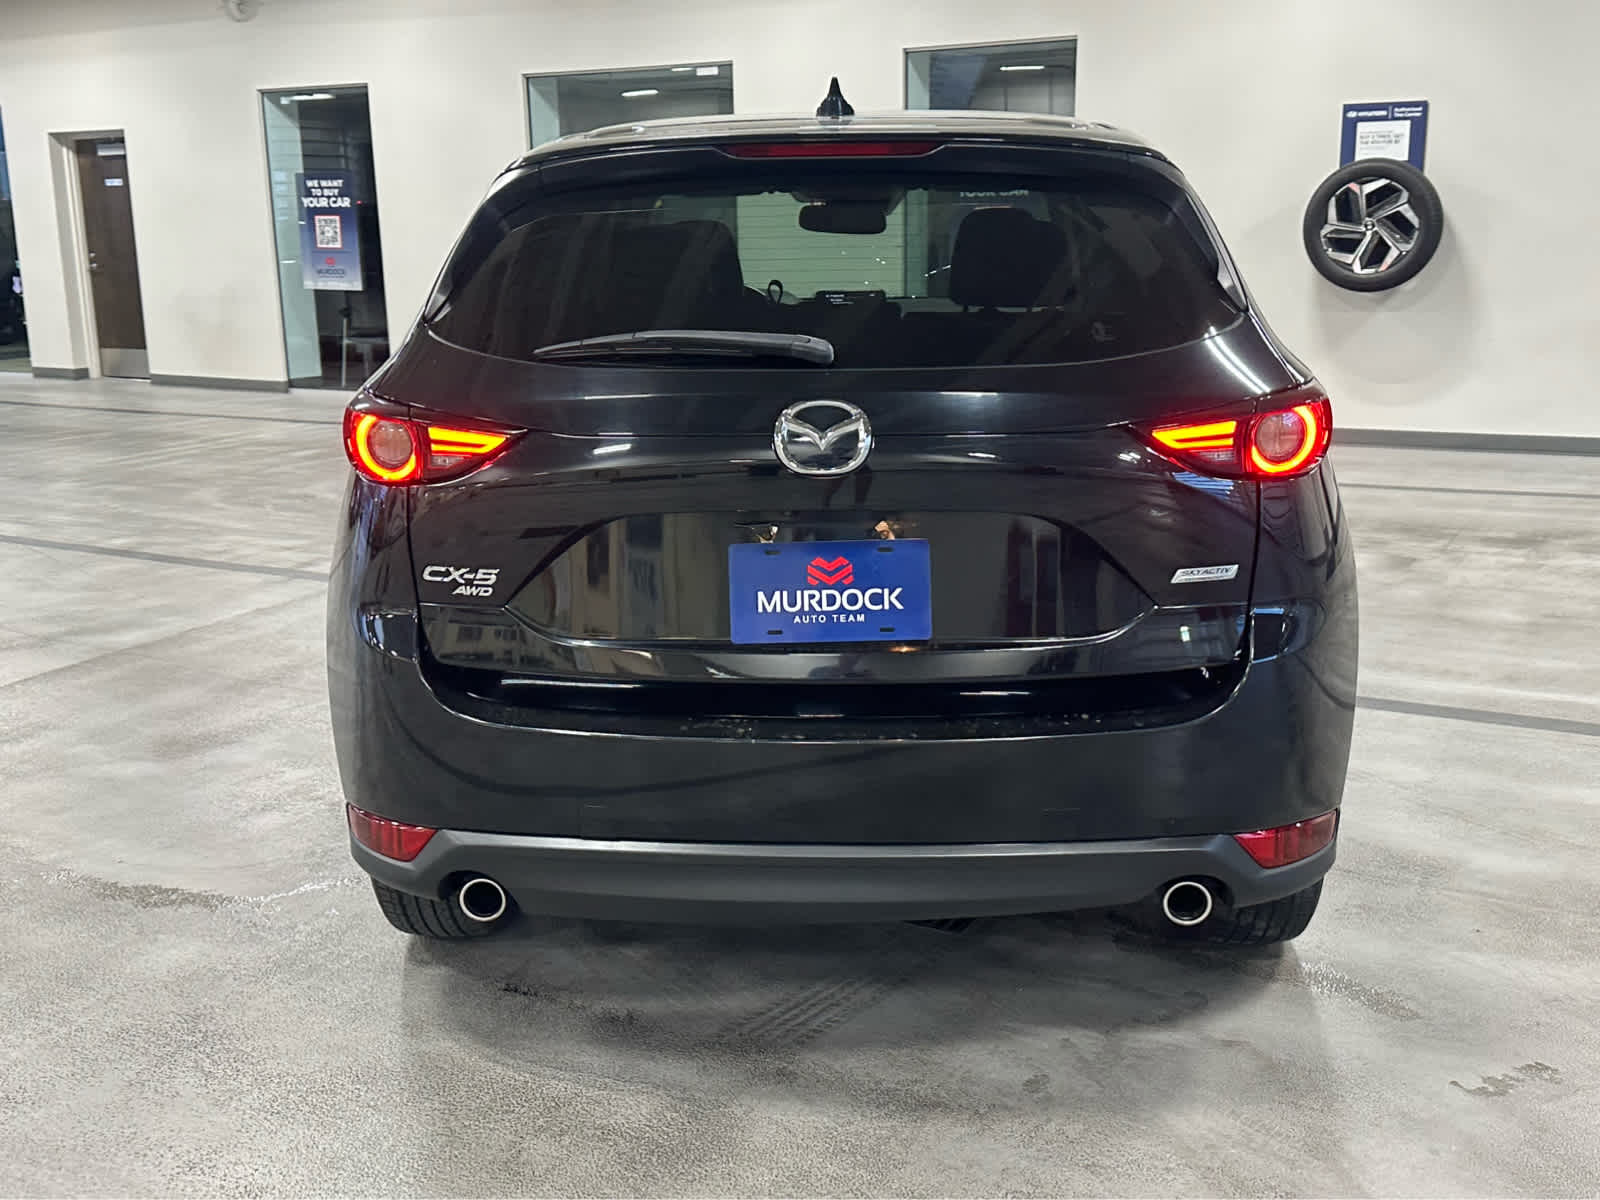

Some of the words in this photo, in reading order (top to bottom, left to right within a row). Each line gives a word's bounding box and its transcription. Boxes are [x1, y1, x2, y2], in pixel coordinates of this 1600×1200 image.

[306, 179, 319, 188] WE
[320, 179, 344, 188] WANT
[310, 188, 322, 196] TO
[323, 188, 339, 196] BUY
[301, 197, 329, 208] YOUR
[329, 197, 351, 208] CAR
[422, 565, 500, 585] CX-5
[1180, 566, 1231, 577] SKYACTIV
[451, 585, 494, 597] AWD
[757, 587, 905, 614] MURDOCK
[793, 615, 826, 624] AUTO
[832, 613, 865, 623] TEAM
